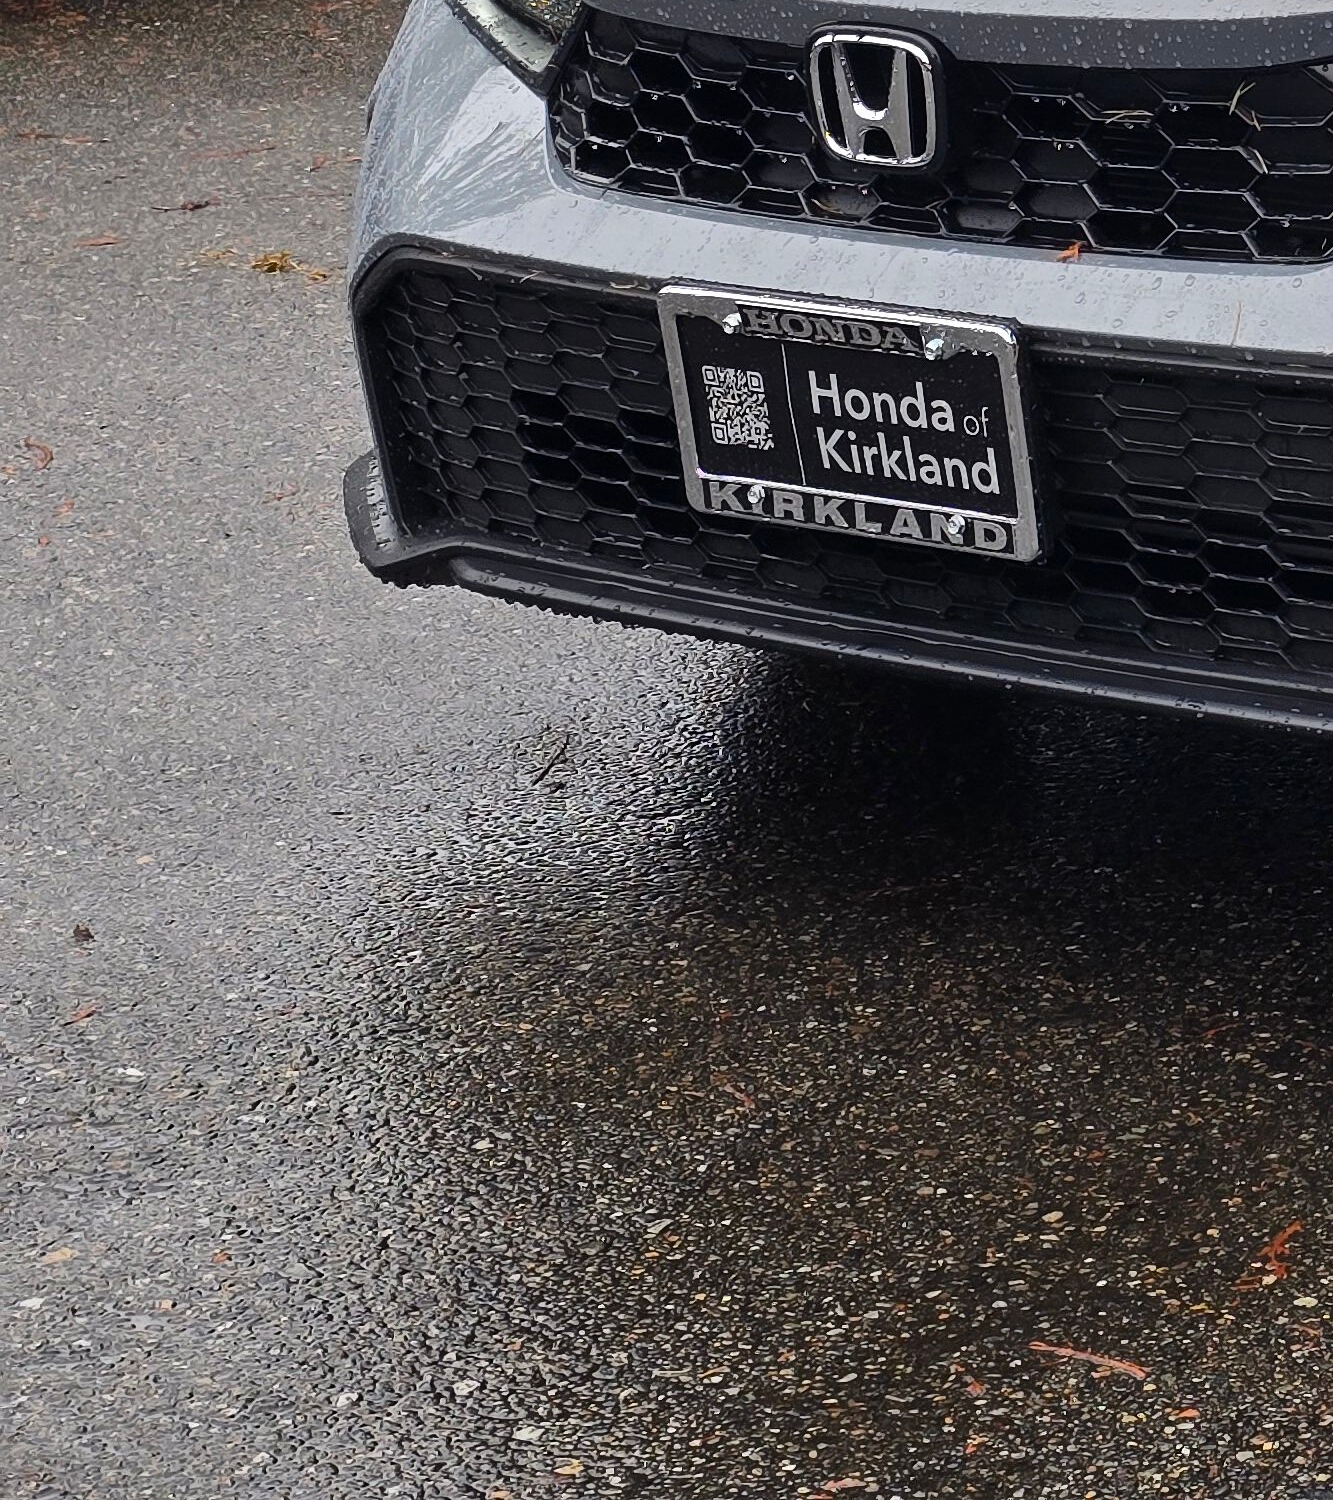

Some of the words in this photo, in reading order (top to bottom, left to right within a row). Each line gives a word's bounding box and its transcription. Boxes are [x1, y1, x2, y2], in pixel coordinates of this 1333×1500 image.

[743, 308, 920, 350] HONDA
[807, 370, 955, 432] Honda
[963, 407, 989, 437] of
[816, 426, 1000, 495] Kirkland
